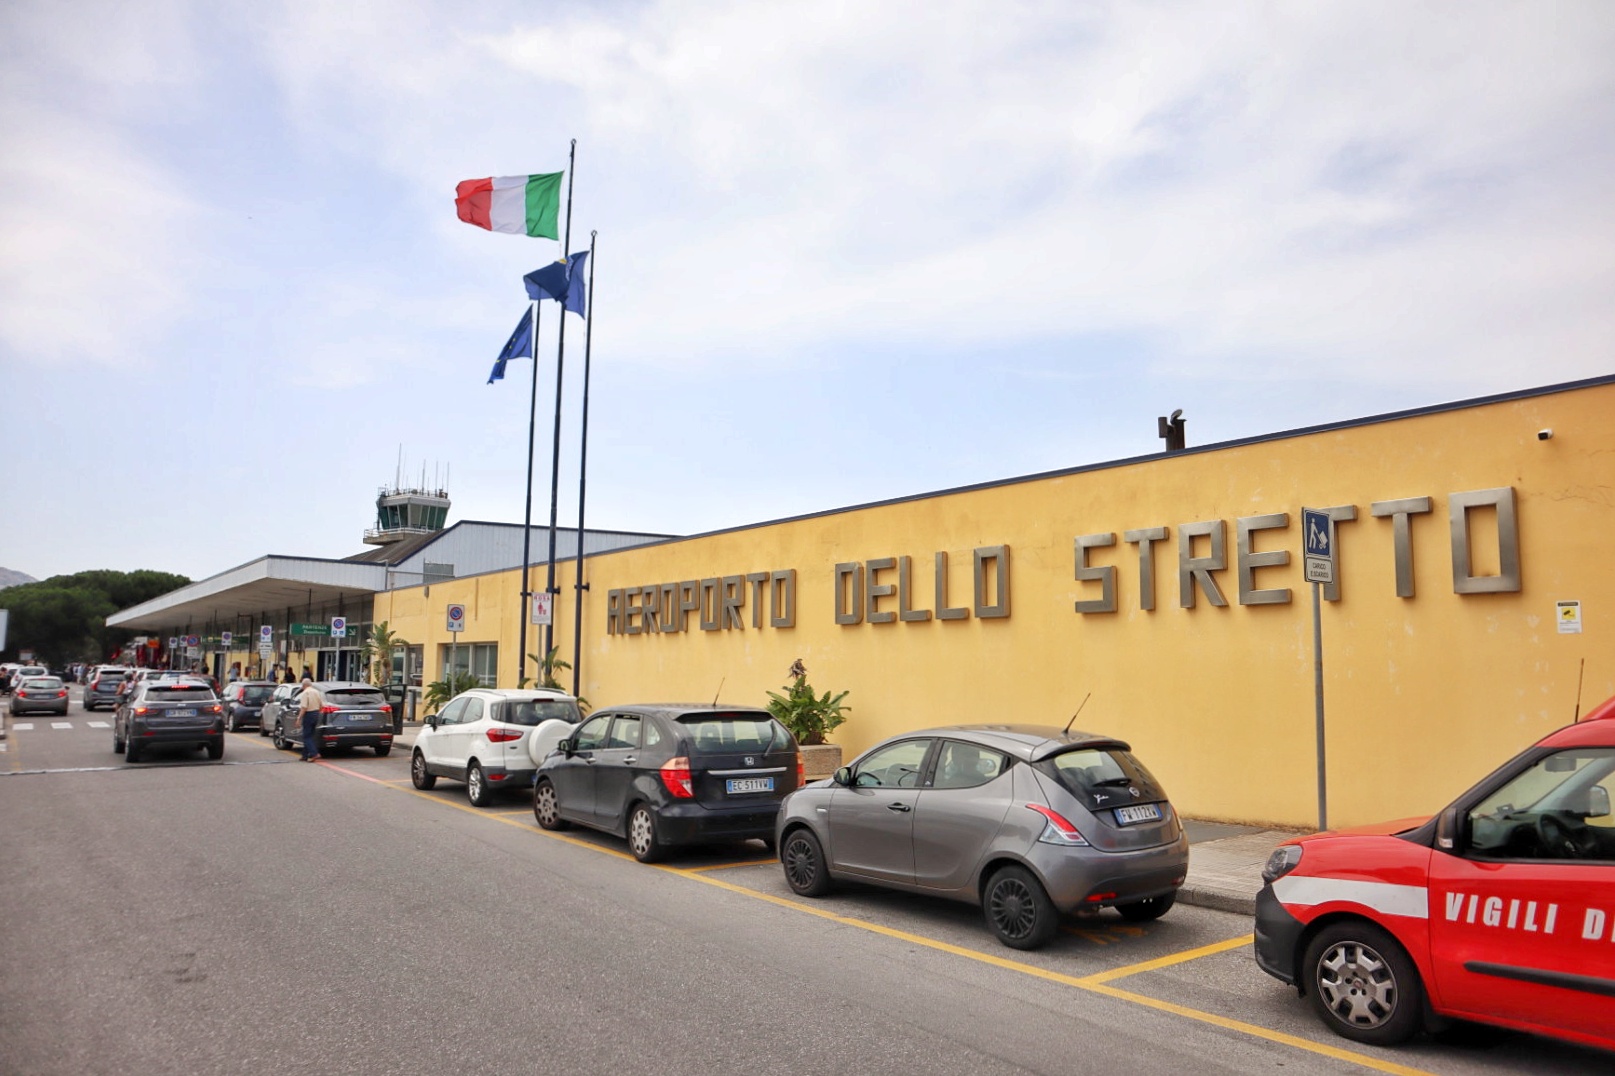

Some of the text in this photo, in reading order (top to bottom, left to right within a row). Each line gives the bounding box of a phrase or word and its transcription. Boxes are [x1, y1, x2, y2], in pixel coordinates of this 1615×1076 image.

[607, 486, 1521, 635] AEROPORTO DELLO STRETTO
[1312, 562, 1327, 570] CARICO
[1445, 892, 1558, 934] VIGILI
